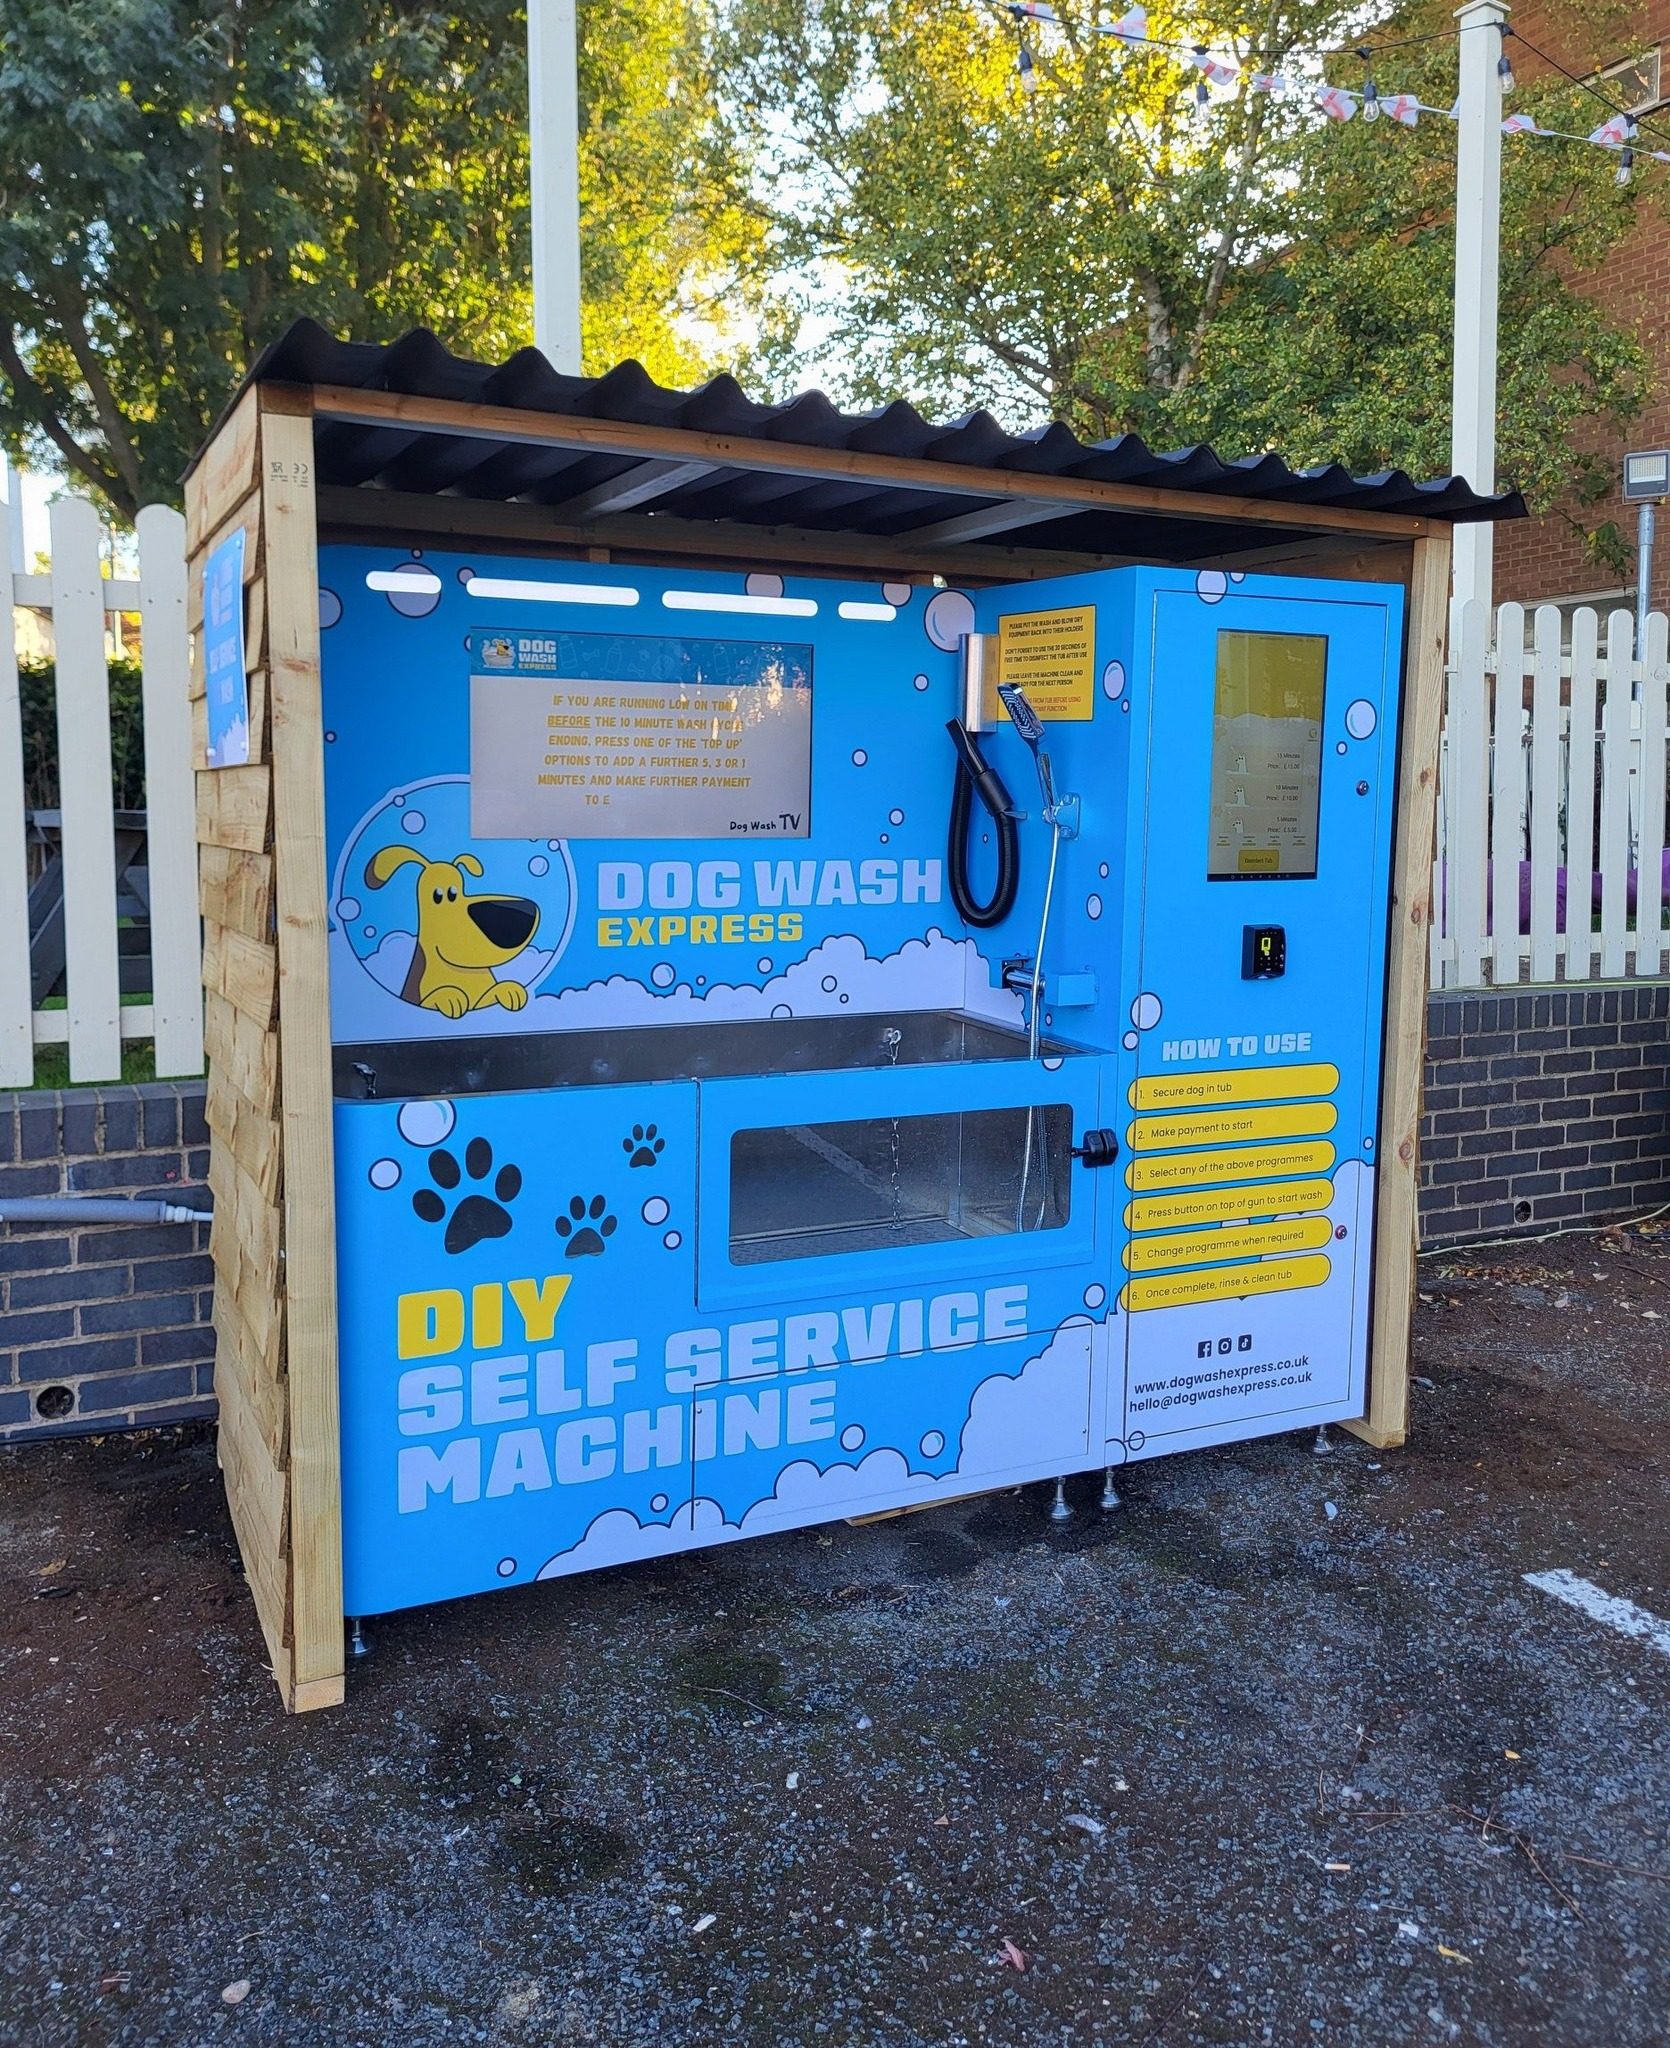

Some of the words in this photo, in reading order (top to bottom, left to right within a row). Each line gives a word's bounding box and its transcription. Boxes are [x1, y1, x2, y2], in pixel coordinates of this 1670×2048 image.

[1008, 630, 1031, 638] EQUIPMENT
[1065, 625, 1084, 633] HOLDERS
[1040, 619, 1052, 627] WASH
[518, 639, 557, 653] DOG
[518, 653, 557, 663] WASH
[1029, 654, 1049, 662] DISINFECT
[1040, 670, 1059, 678] MACHINE
[553, 695, 564, 706] IF
[567, 695, 589, 706] YOU
[593, 696, 617, 708] ARE
[620, 697, 665, 709] RUNNING
[669, 699, 689, 710] LOW
[694, 700, 708, 711] ON
[547, 715, 591, 728] BEFORE
[595, 716, 617, 727] THE
[620, 717, 631, 728] 10
[634, 718, 673, 729] MINUTE
[677, 719, 706, 730] WASH
[595, 736, 630, 747] PRESS
[633, 737, 655, 748] ONE
[658, 737, 671, 748] OF
[675, 738, 697, 749] THE
[544, 754, 591, 766] OPTIONS
[595, 755, 609, 766] TO
[613, 756, 635, 767] ADD
[638, 756, 647, 767] A
[650, 757, 698, 768] FURTHER
[715, 758, 721, 768] 3
[725, 758, 738, 768] OR
[538, 774, 586, 785] MINUTES
[590, 775, 612, 786] AND
[616, 775, 647, 786] MAKE
[650, 776, 698, 787] FURTHER
[702, 777, 751, 788] PAYMENT
[585, 794, 599, 805] TO
[602, 795, 610, 805] E
[729, 821, 748, 832] Dog
[750, 820, 776, 830] Wash
[779, 813, 801, 831] TV
[597, 861, 742, 911] DOG
[753, 859, 942, 907] WASH
[597, 913, 803, 947] EXPRESS
[1162, 1038, 1221, 1062] HOW
[1227, 1035, 1258, 1057] TO
[1264, 1032, 1312, 1055] USE
[1138, 1090, 1145, 1099] 1.
[1152, 1086, 1184, 1098] Secure
[1186, 1084, 1205, 1097] dog
[1206, 1083, 1215, 1093] in
[1217, 1082, 1232, 1093] tub
[1137, 1131, 1145, 1140] 2.
[1150, 1127, 1176, 1138] Make
[1177, 1123, 1219, 1137] payment
[1221, 1122, 1230, 1131] to
[1232, 1120, 1253, 1130] start
[1136, 1171, 1144, 1180] 3.
[1149, 1167, 1177, 1178] Select
[1179, 1165, 1196, 1177] any
[1198, 1163, 1208, 1173] of
[1209, 1161, 1225, 1172] the
[1226, 1159, 1254, 1170] above
[1256, 1153, 1314, 1169] programmes
[1134, 1211, 1143, 1220] 4.
[1148, 1207, 1172, 1218] Press
[1174, 1203, 1204, 1215] button
[1206, 1203, 1218, 1213] on
[1220, 1201, 1235, 1213] top
[1237, 1198, 1247, 1208] of
[1247, 1198, 1265, 1210] gun
[1267, 1196, 1276, 1205] to
[1278, 1192, 1298, 1203] start
[1299, 1190, 1323, 1202] wash
[1133, 1252, 1141, 1261] 5.
[1147, 1246, 1184, 1259] Change
[1185, 1239, 1240, 1256] programme
[1241, 1236, 1266, 1247] when
[1267, 1230, 1304, 1244] required
[1131, 1291, 1140, 1301] 6.
[1145, 1286, 1170, 1298] Once
[1171, 1281, 1218, 1295] complete,
[1219, 1277, 1240, 1288] rinse
[1242, 1276, 1249, 1285] &
[1251, 1272, 1276, 1283] clean
[1277, 1270, 1292, 1280] tub
[397, 1273, 573, 1361] DIY
[397, 1338, 639, 1437] SELF
[664, 1284, 1030, 1395] SERVICE
[1134, 1354, 1309, 1395] www.dogwashexpress.co.uk
[1129, 1371, 1313, 1413] hello@dogwashexpress.co.uk
[397, 1380, 838, 1515] MACHINE
